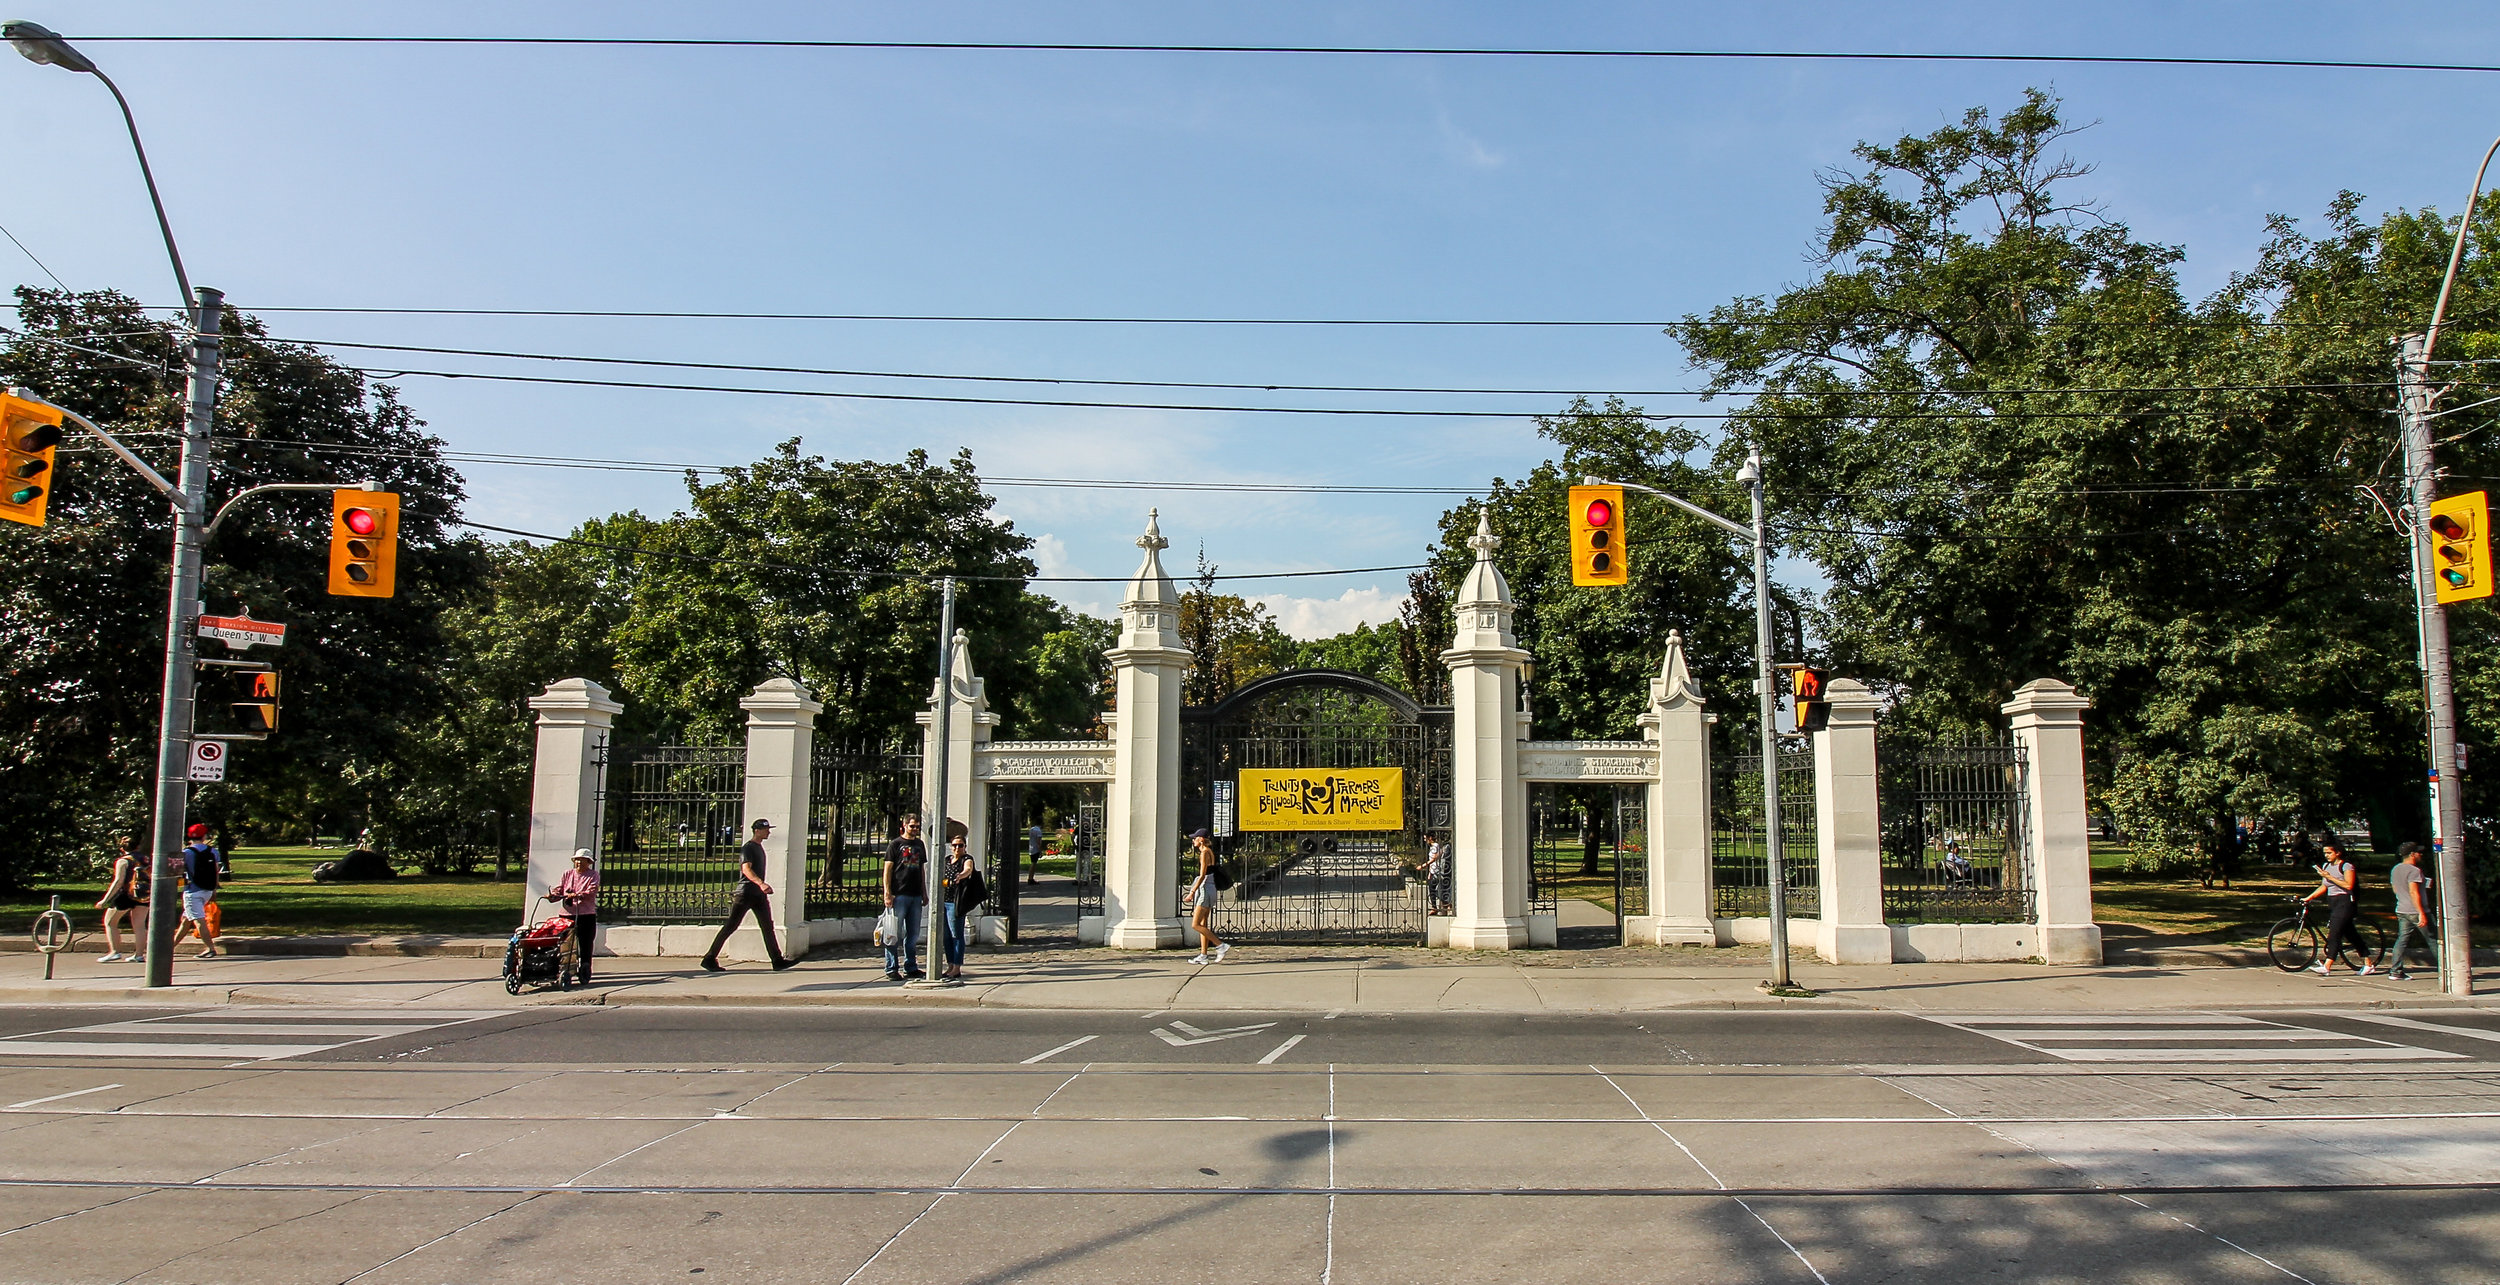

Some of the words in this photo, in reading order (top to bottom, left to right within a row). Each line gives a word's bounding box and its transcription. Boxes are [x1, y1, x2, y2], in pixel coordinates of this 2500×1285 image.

[212, 627, 241, 640] Queen
[244, 631, 255, 642] St.
[259, 633, 269, 643] W.
[1005, 758, 1045, 766] ACADEMIA
[1262, 778, 1299, 793] TRINITY
[1335, 778, 1379, 794] FARMERS
[1259, 794, 1302, 815] BELLWOODS
[1340, 795, 1385, 814] MARKET
